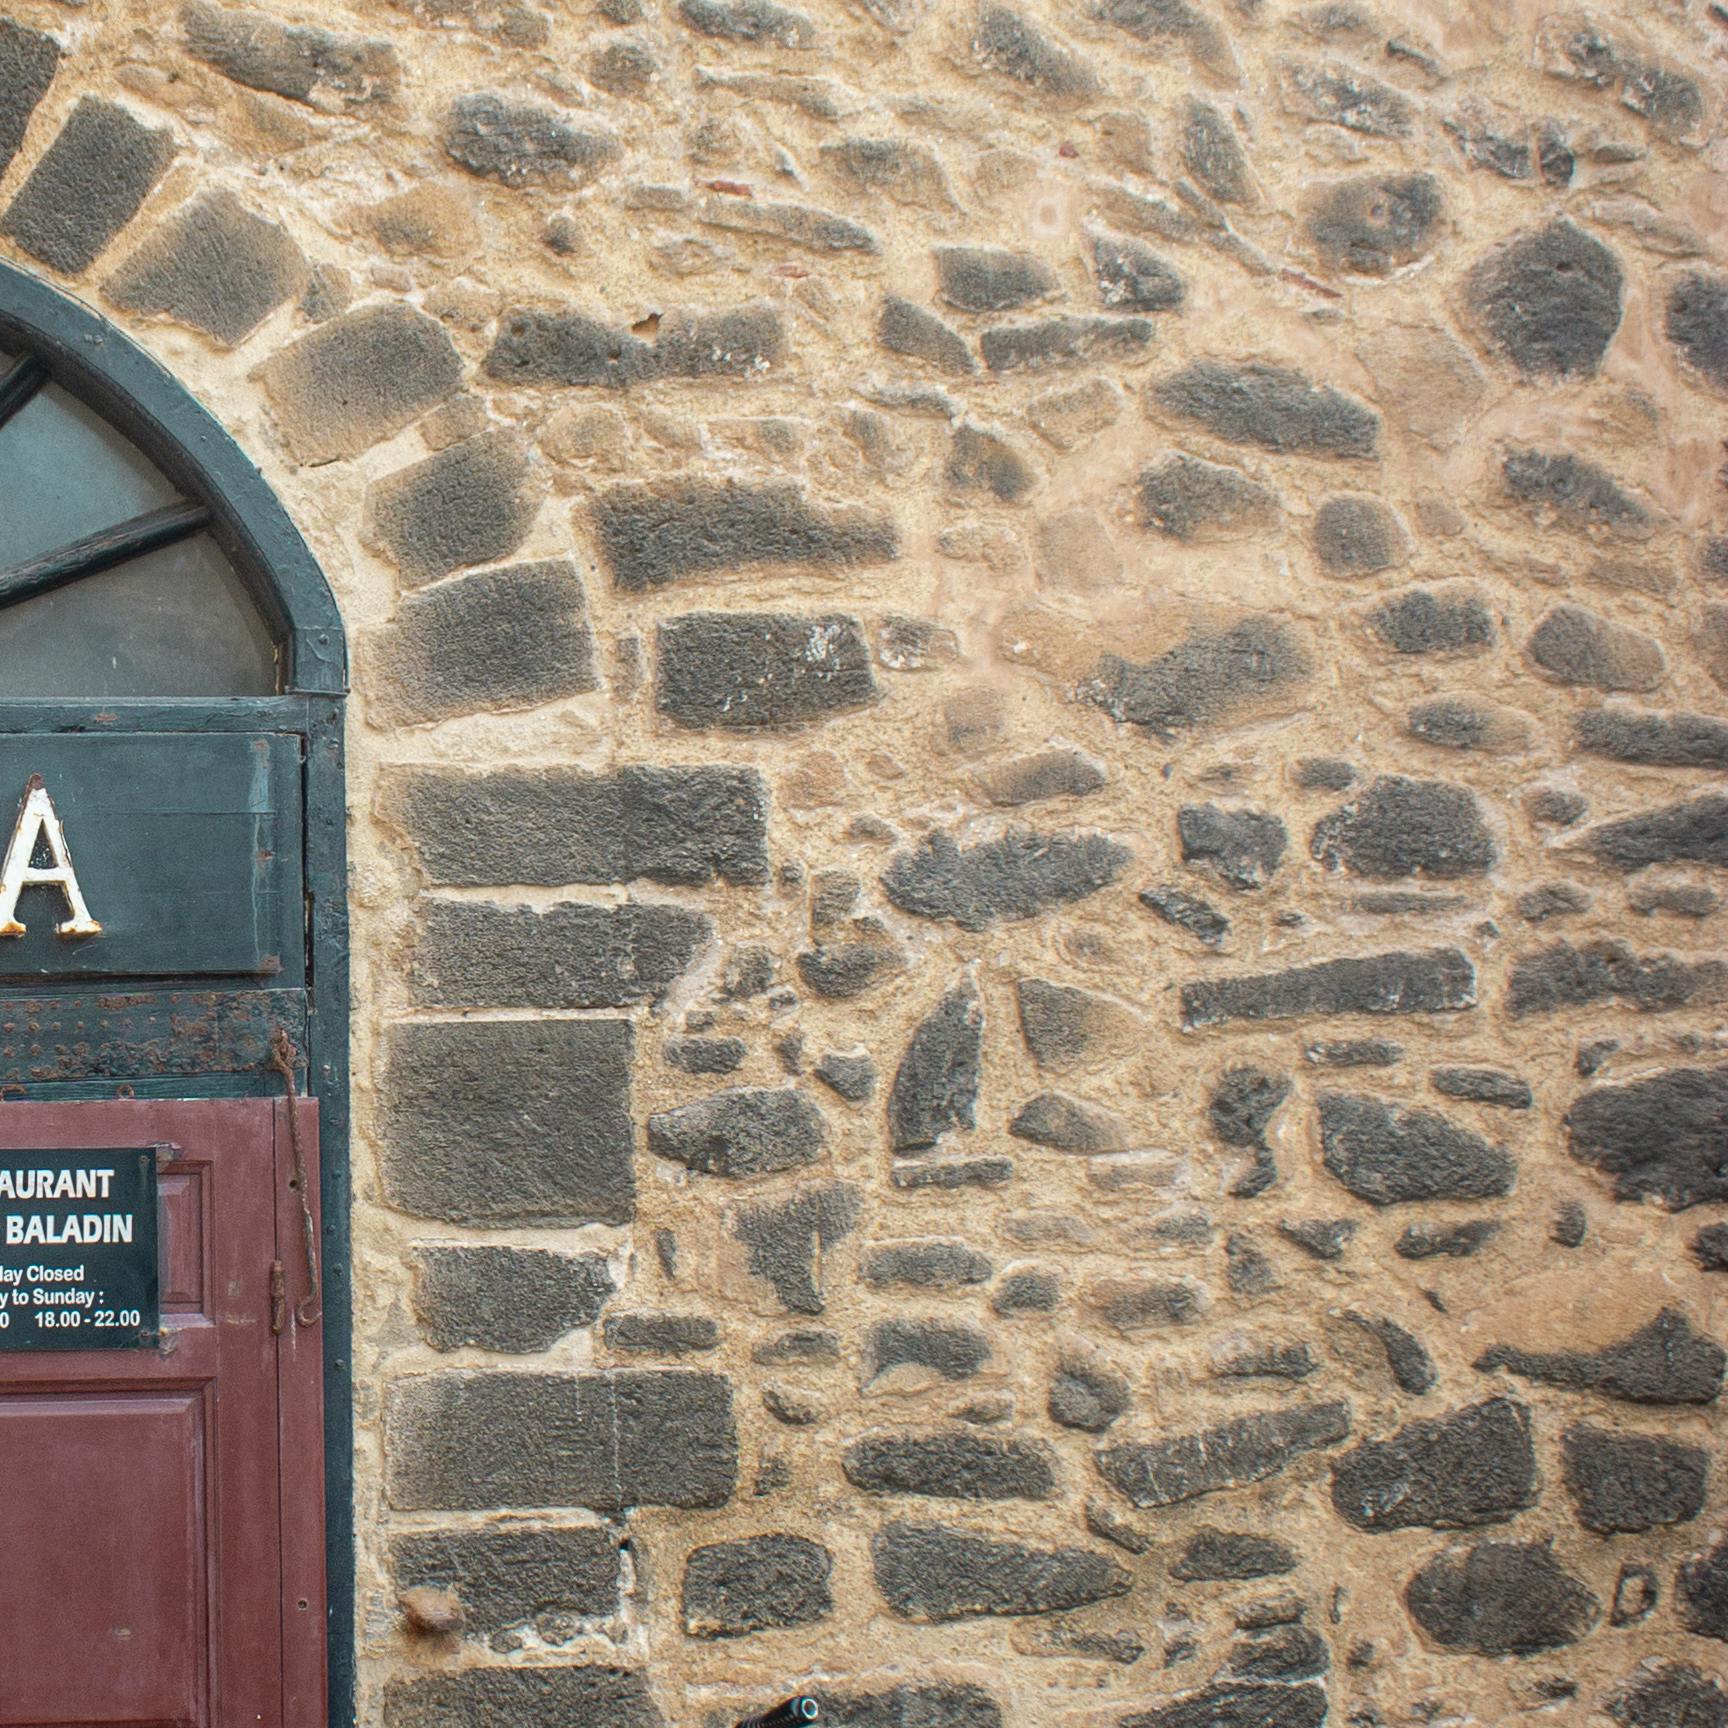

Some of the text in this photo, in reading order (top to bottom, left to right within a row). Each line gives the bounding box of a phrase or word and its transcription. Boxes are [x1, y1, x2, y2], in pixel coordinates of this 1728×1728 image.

[5, 1214, 133, 1245] BALADIN
[26, 1264, 85, 1283] Closed
[11, 1288, 30, 1306] to
[32, 1287, 96, 1308] Sunday
[34, 1310, 81, 1329] 18.00
[94, 1309, 141, 1328] 22.00
